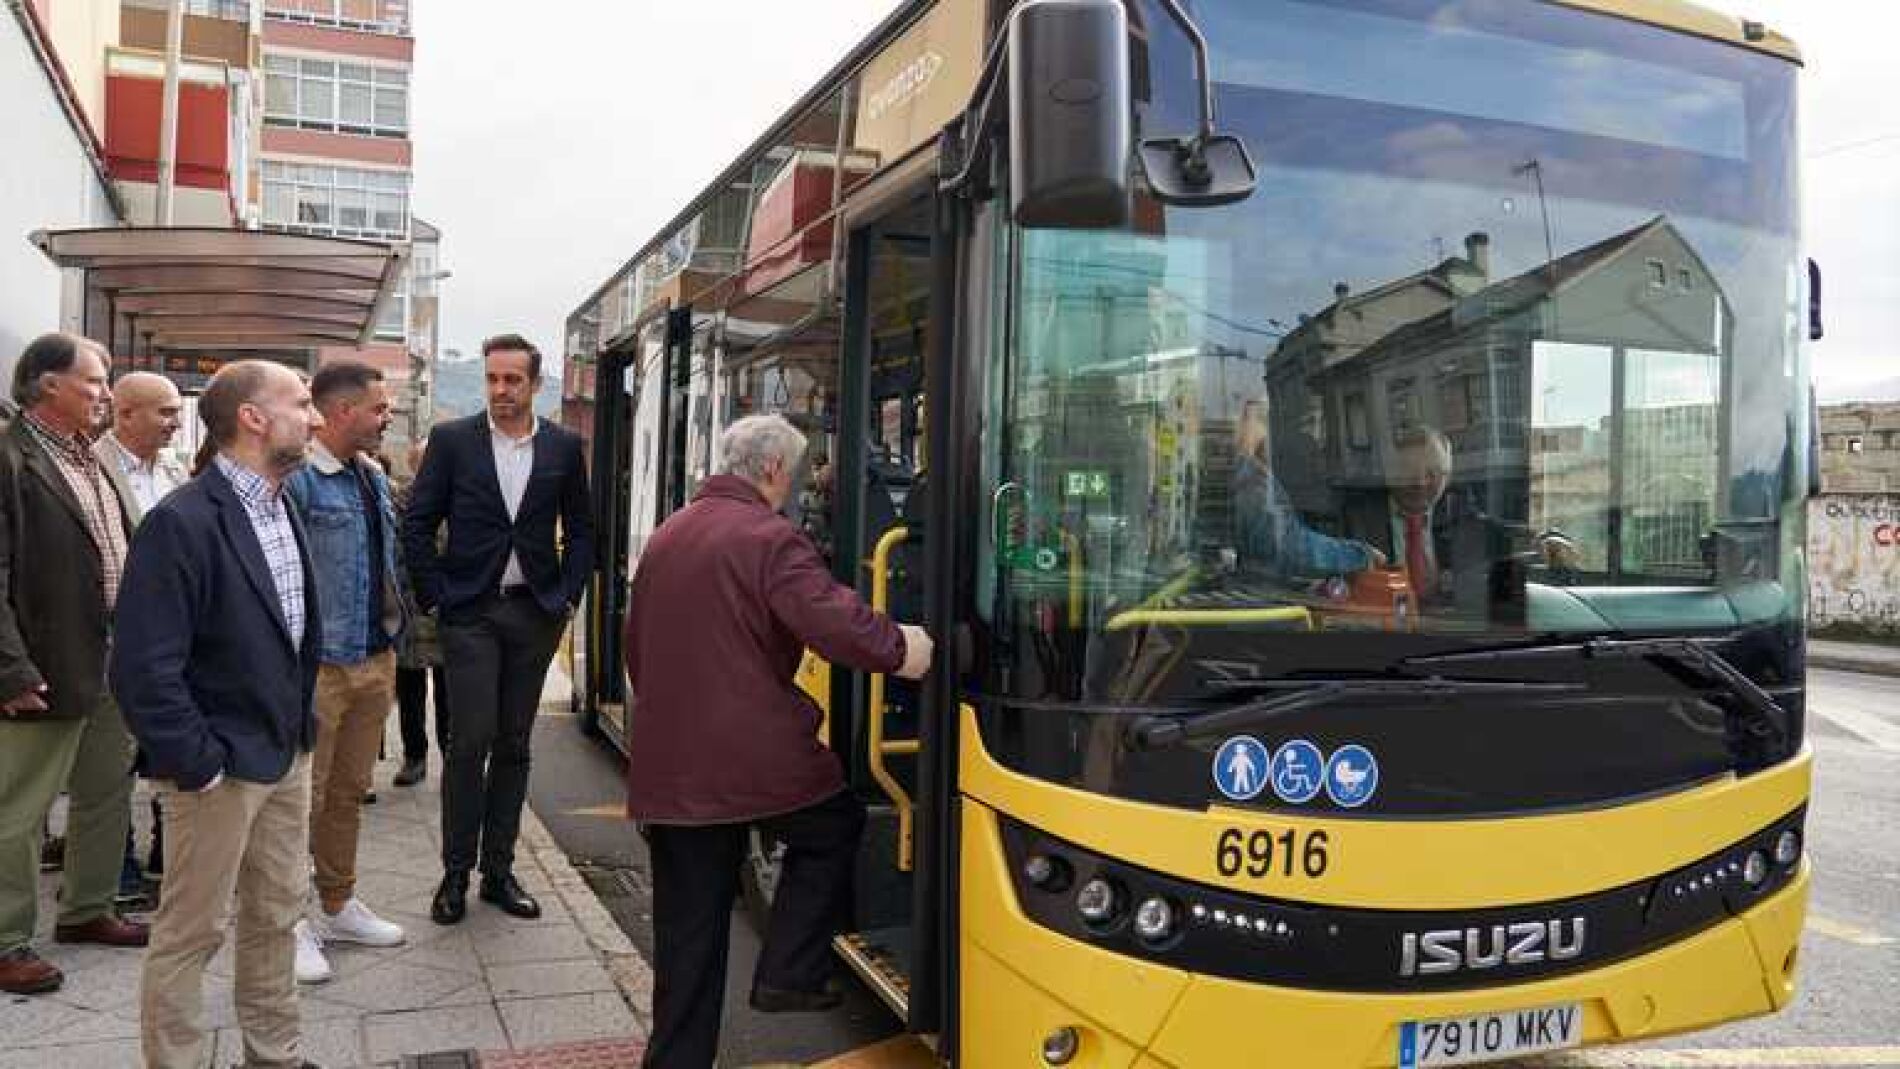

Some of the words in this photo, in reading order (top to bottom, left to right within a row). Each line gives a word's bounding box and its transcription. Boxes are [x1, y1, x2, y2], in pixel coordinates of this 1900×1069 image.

[1216, 828, 1329, 877] 6916
[1400, 917, 1585, 976] ISUZU
[1421, 1016, 1502, 1062] 7910
[1516, 1005, 1575, 1050] MKV
